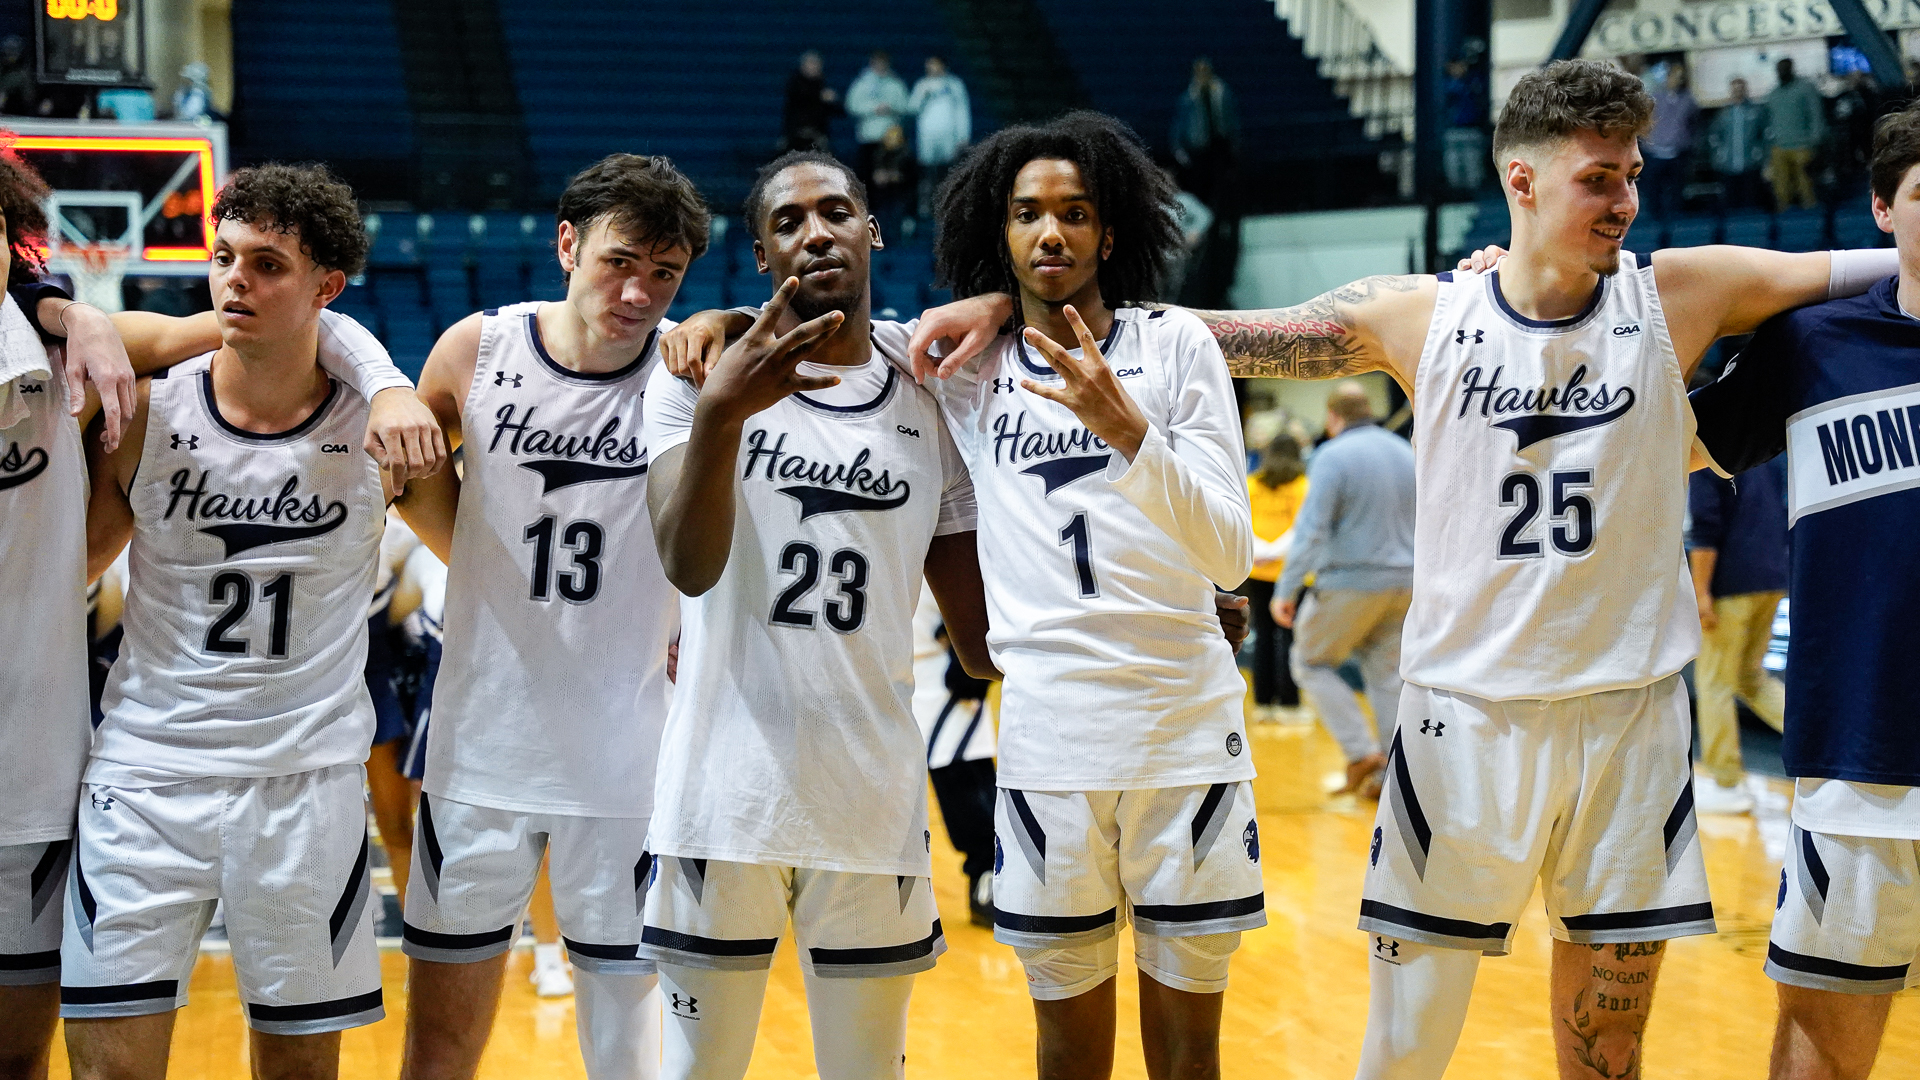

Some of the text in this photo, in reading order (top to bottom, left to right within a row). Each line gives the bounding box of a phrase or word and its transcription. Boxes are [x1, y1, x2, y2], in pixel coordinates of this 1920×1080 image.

[1598, 0, 1920, 44] CONCESSN
[1613, 324, 1641, 336] CAA
[1116, 366, 1144, 378] CAA
[1458, 364, 1635, 420] Hawks
[321, 443, 349, 454] CAA
[488, 403, 647, 463] Hawks
[897, 425, 920, 438] CAA
[992, 410, 1110, 467] Haw
[742, 429, 910, 496] Hawks
[163, 468, 348, 523] Hawks
[1497, 467, 1597, 560] 25
[523, 513, 606, 606] 13
[1058, 510, 1100, 599] 1
[201, 569, 295, 660] 21
[768, 540, 870, 635] 23
[1592, 966, 1649, 984] NO GAIN
